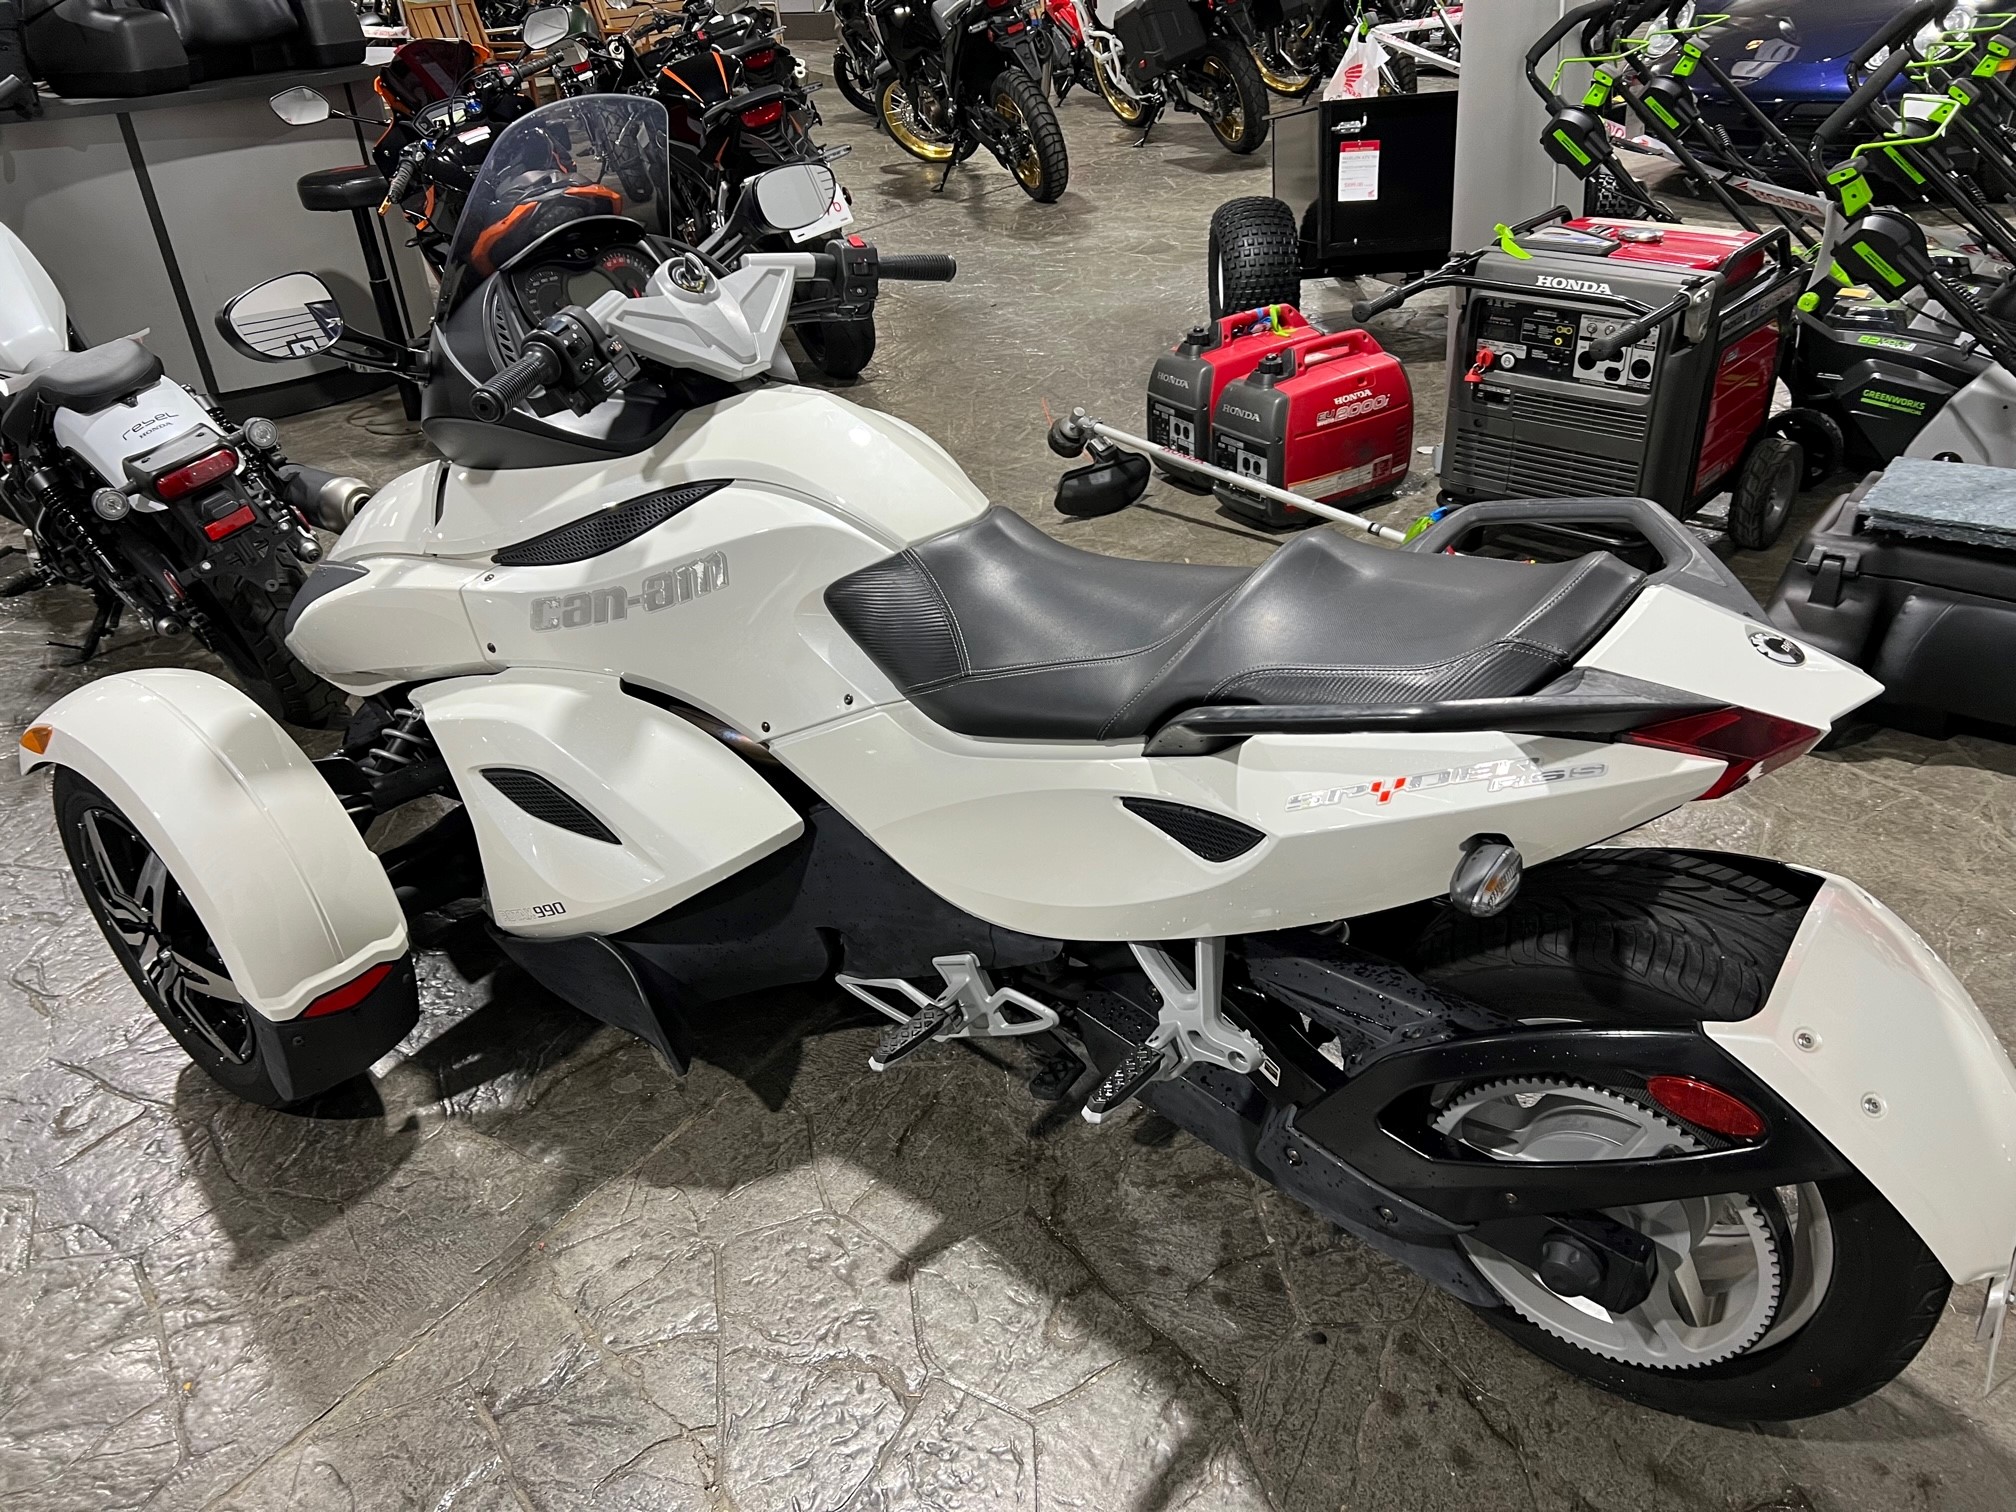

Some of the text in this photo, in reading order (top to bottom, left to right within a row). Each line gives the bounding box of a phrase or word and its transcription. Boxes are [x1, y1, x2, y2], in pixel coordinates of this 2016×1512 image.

[1535, 275, 1613, 295] HONDA
[1157, 371, 1189, 389] HONDA
[1334, 389, 1372, 405] HONDA
[1862, 388, 1926, 411] GREENWORKS
[1222, 403, 1261, 423] HONDA
[139, 421, 174, 439] HONDA
[530, 550, 730, 633] can-am
